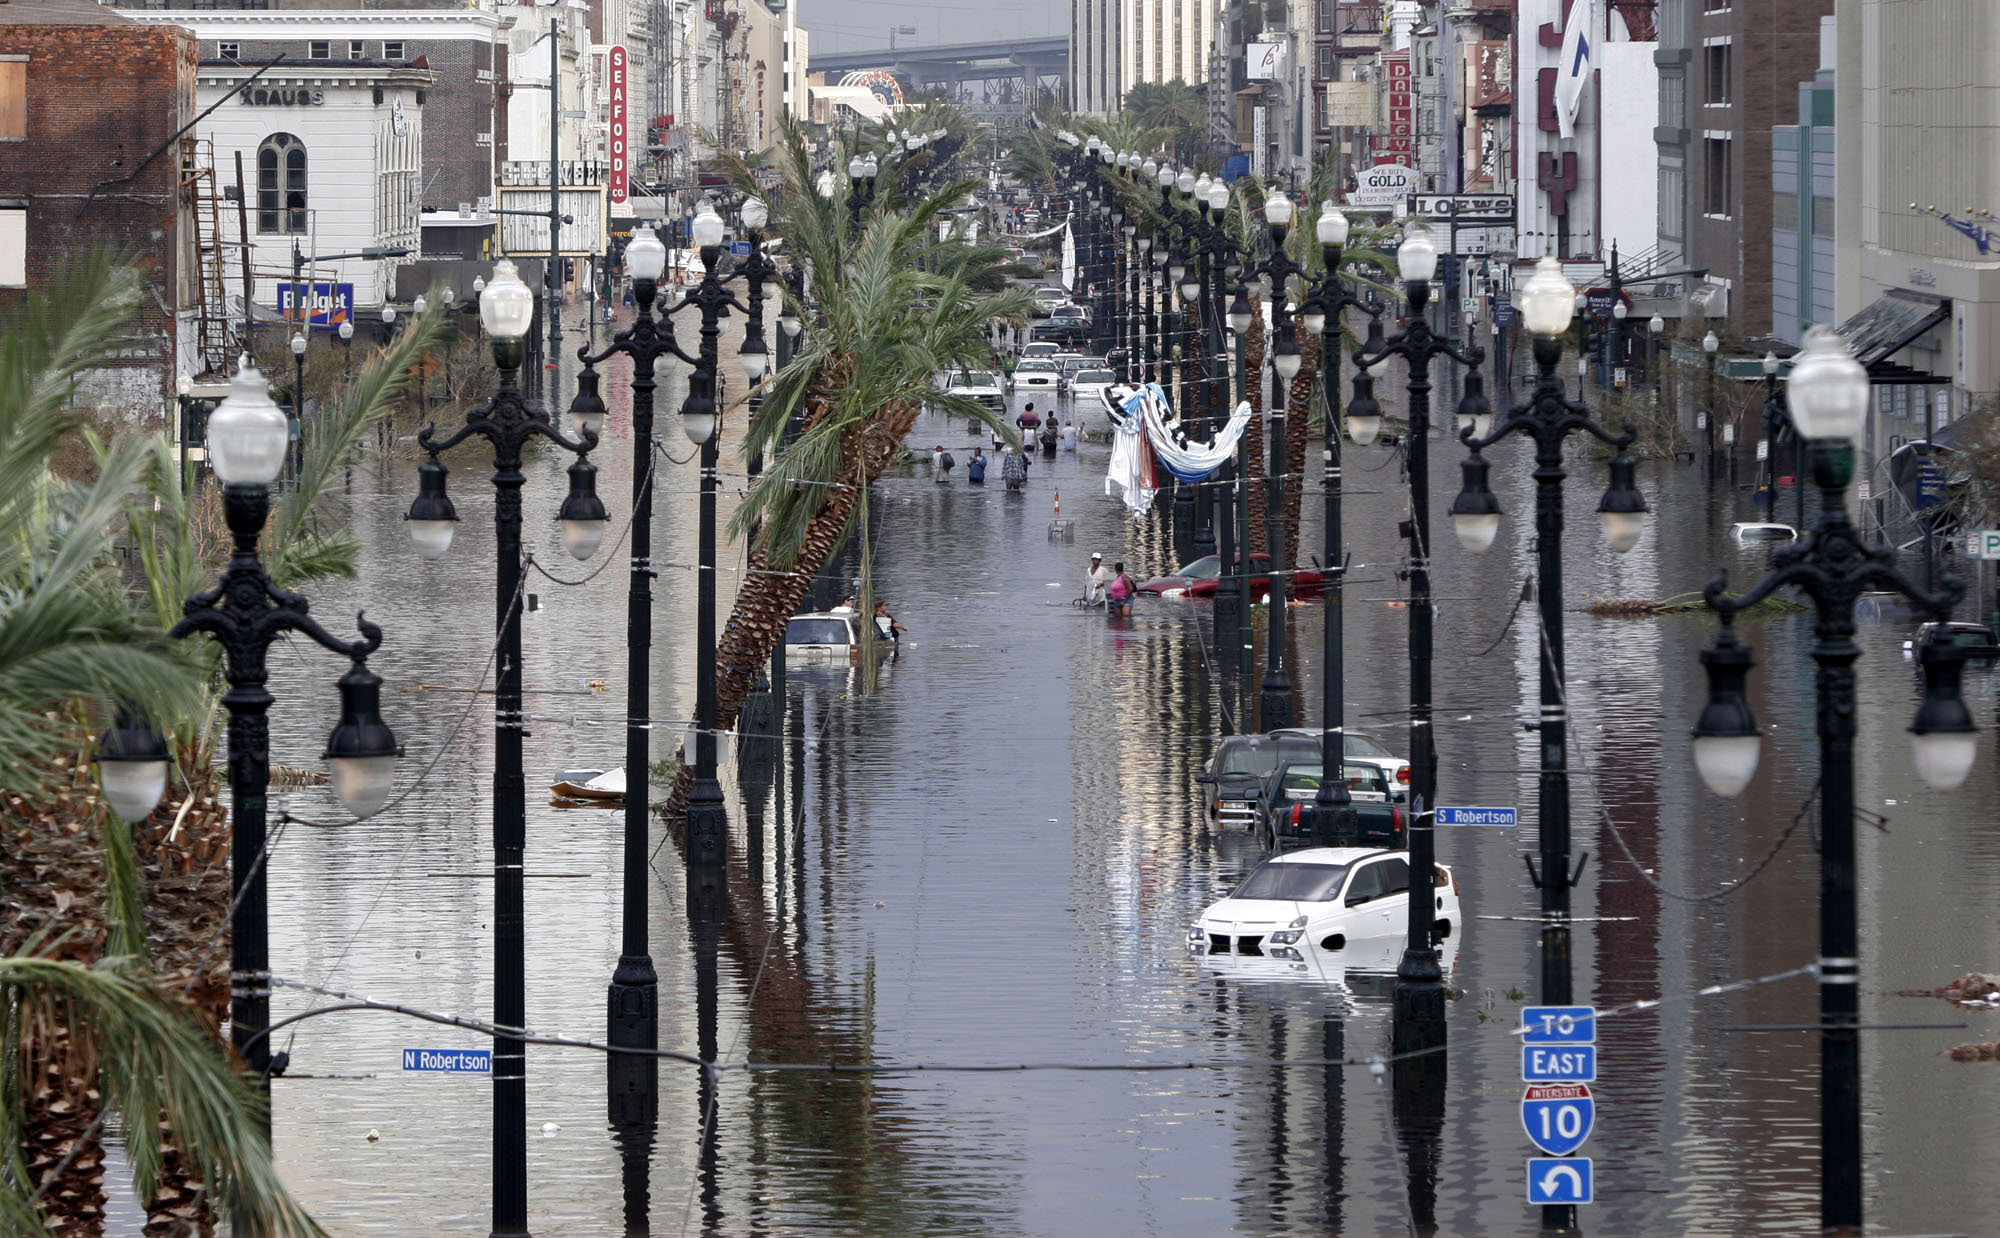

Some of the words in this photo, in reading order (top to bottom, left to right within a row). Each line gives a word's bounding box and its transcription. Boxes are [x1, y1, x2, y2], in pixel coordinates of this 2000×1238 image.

[240, 86, 324, 106] KRAUSS
[613, 52, 623, 172] SEAFOOD
[615, 175, 622, 185] &
[1368, 175, 1406, 187] GOLD
[612, 188, 625, 198] CO.
[1418, 199, 1509, 214] LOEWS
[1439, 809, 1446, 823] S
[1455, 809, 1513, 824] Robertson
[1540, 1014, 1575, 1035] TO
[405, 1051, 415, 1068] N
[420, 1051, 488, 1070] Robertson
[1532, 1050, 1586, 1075] EAST
[1532, 1087, 1582, 1099] INTERSTATE
[1539, 1105, 1582, 1140] 10
